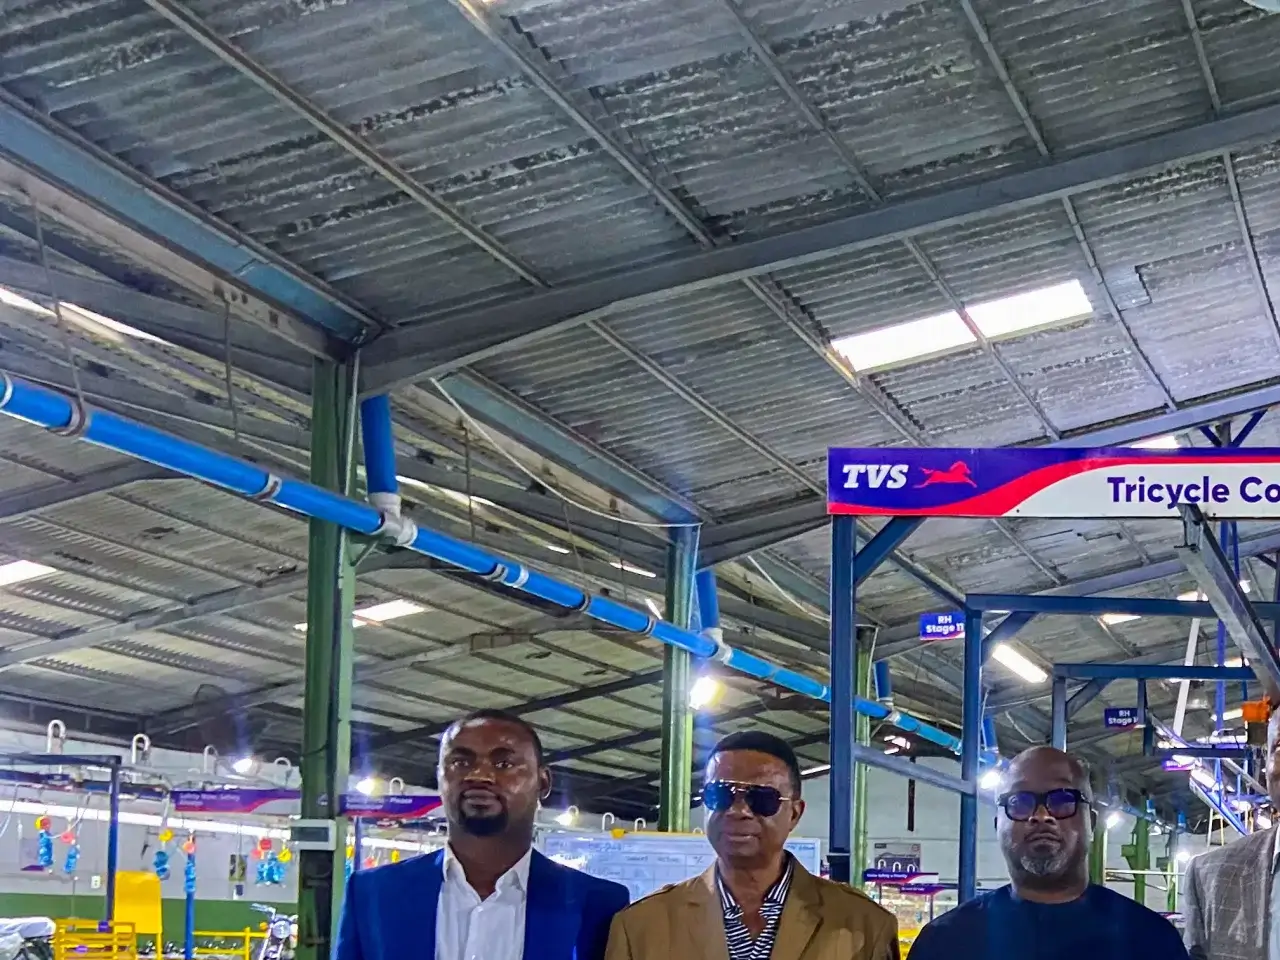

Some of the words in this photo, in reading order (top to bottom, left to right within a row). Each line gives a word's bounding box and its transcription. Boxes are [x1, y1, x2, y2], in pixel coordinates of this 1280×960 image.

[842, 464, 909, 489] TVS
[1107, 475, 1230, 510] Tricycle
[937, 615, 952, 624] RH
[926, 624, 955, 635] Stage
[1108, 717, 1132, 726] Stage
